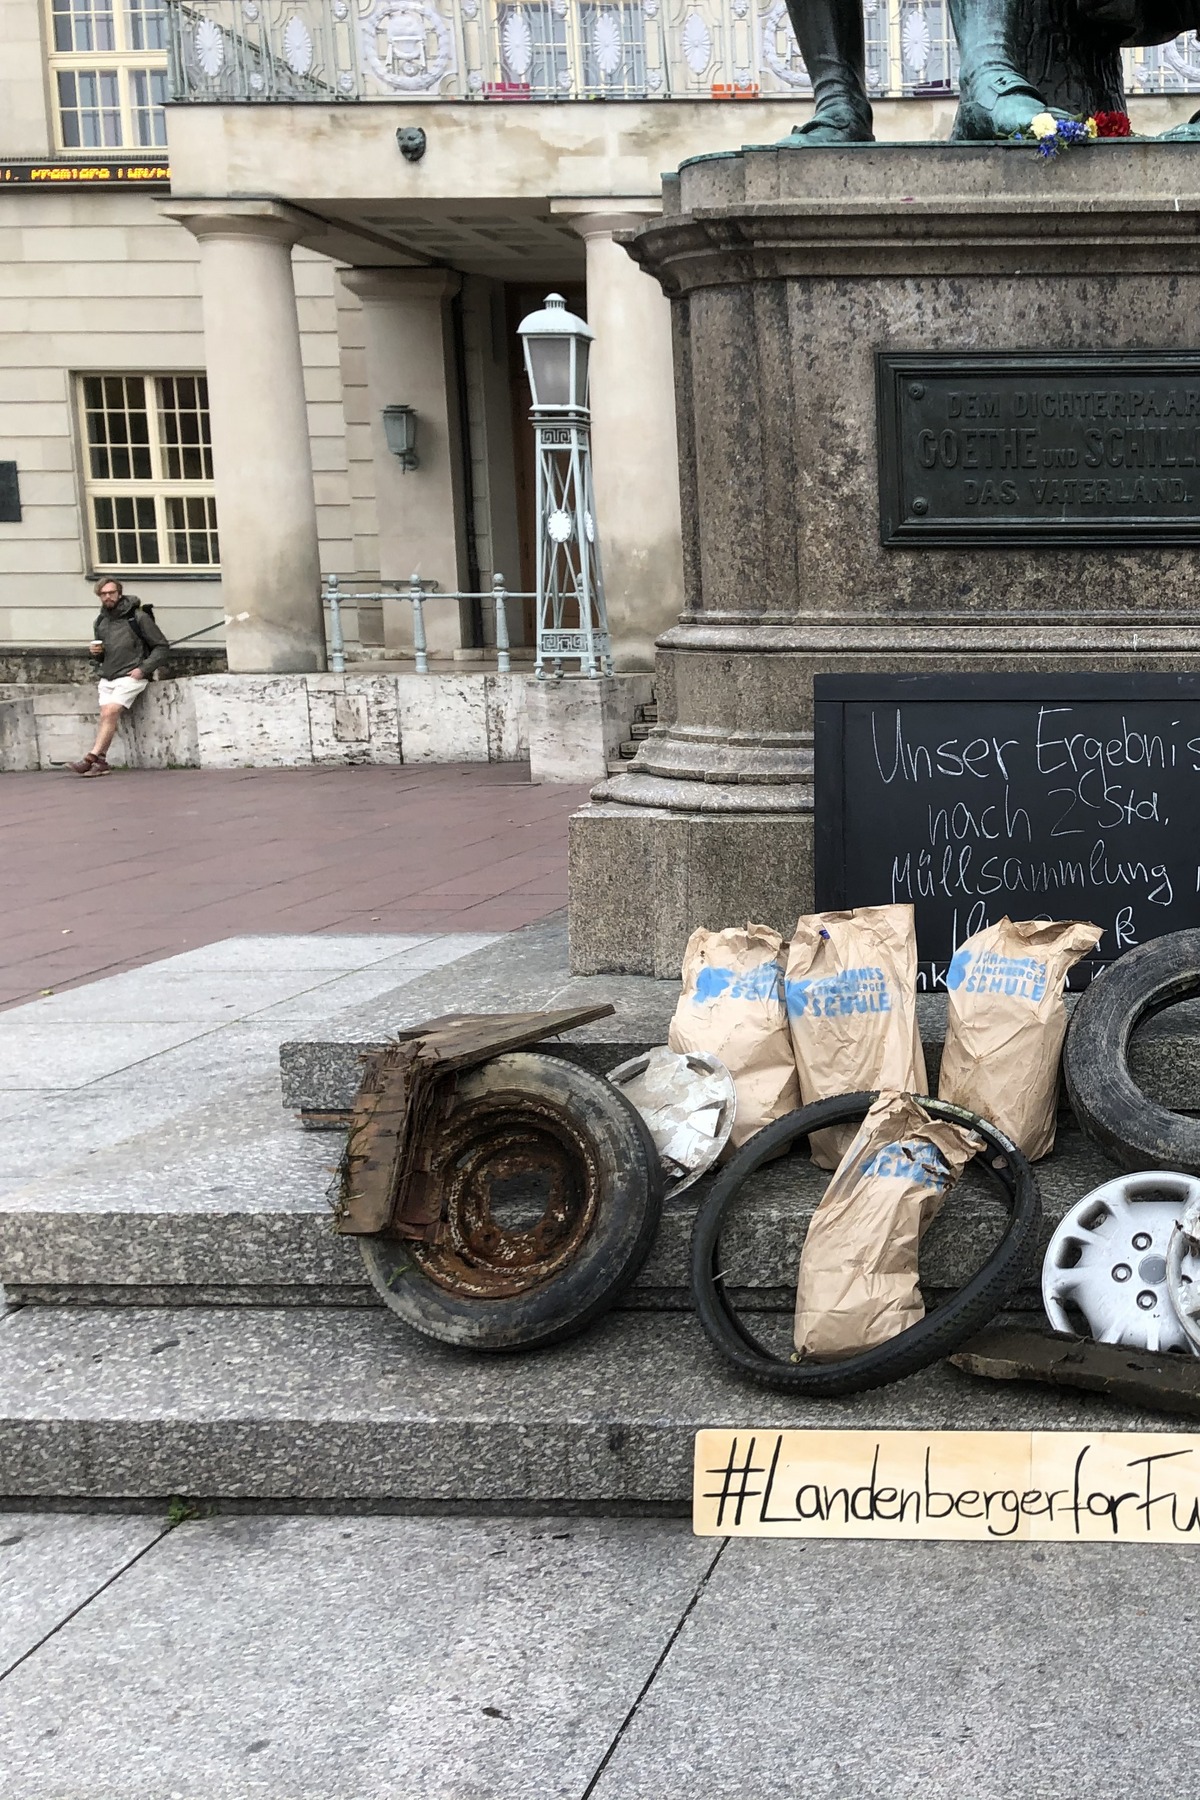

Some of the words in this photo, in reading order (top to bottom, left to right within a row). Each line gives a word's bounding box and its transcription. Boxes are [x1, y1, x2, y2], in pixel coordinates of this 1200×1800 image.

[948, 391, 1000, 418] DEM
[917, 427, 1038, 469] GOETHE
[1042, 447, 1079, 469] UND
[964, 479, 1017, 505] DAS
[871, 708, 1019, 784] Unser
[928, 785, 1032, 846] nach
[1047, 788, 1085, 837] 2
[1098, 784, 1170, 828] Std.
[891, 839, 1175, 906] Müllsammlung
[812, 992, 892, 1017] SCHULE
[965, 975, 1046, 1002] SCHULE
